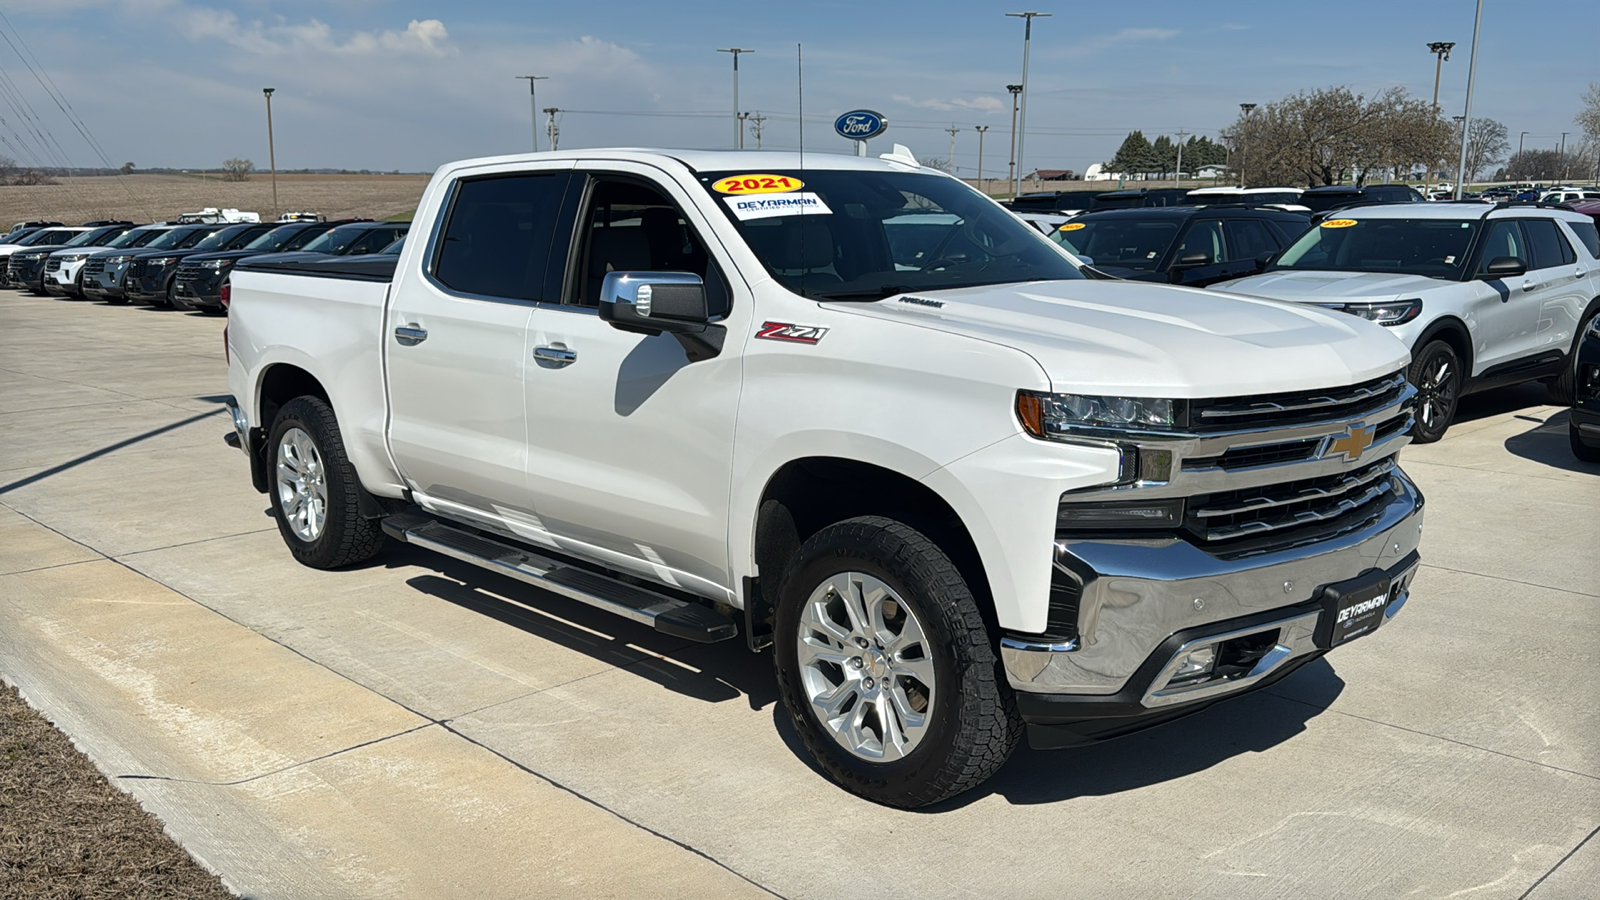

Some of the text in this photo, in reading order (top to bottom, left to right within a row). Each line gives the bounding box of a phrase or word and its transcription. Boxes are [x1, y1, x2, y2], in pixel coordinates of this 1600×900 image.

[843, 115, 872, 133] Ford
[724, 177, 792, 192] 2021
[737, 198, 817, 210] DEYARMAN
[754, 320, 830, 345] Z71
[1337, 593, 1388, 624] DEYARMAN
